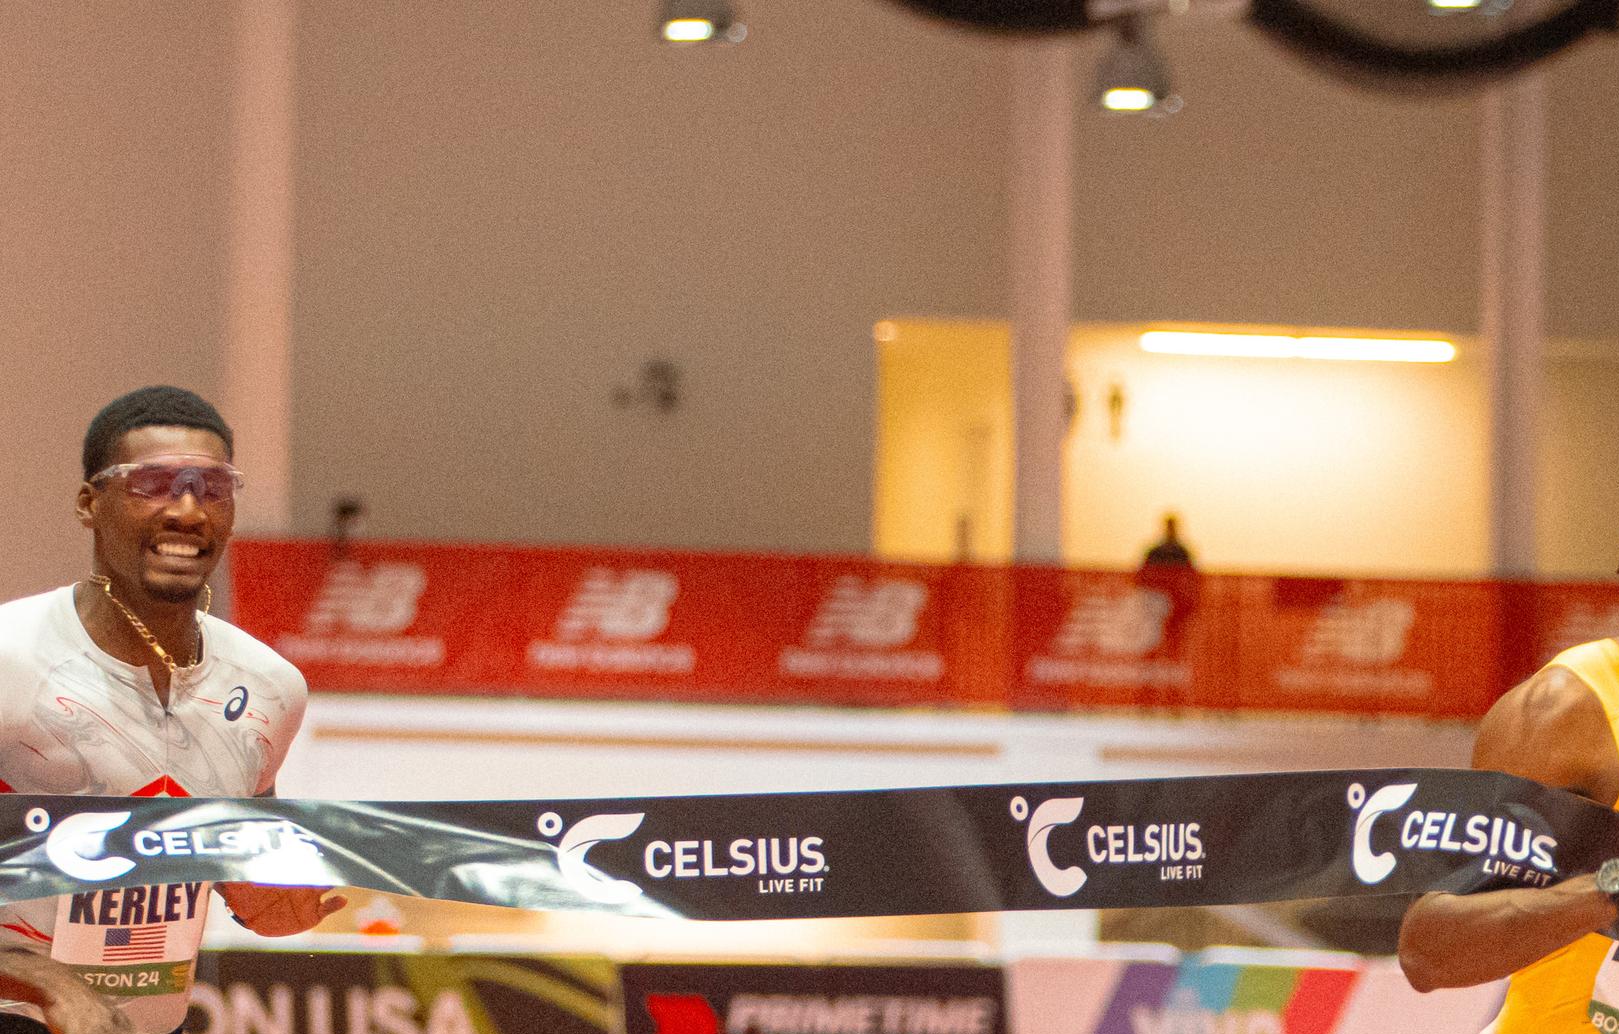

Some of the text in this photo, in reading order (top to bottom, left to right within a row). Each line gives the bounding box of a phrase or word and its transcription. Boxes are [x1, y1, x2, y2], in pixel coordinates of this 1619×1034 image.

[644, 836, 826, 878] CELSIUS
[1087, 822, 1204, 863] CELSIUS
[1402, 810, 1558, 870] CELSIUS
[759, 877, 824, 894] LIVE FIT
[1160, 865, 1203, 880] LIVE FIT
[1482, 858, 1551, 886] LIVE FIT
[69, 882, 202, 926] KERLEY
[79, 971, 160, 988] STON 24
